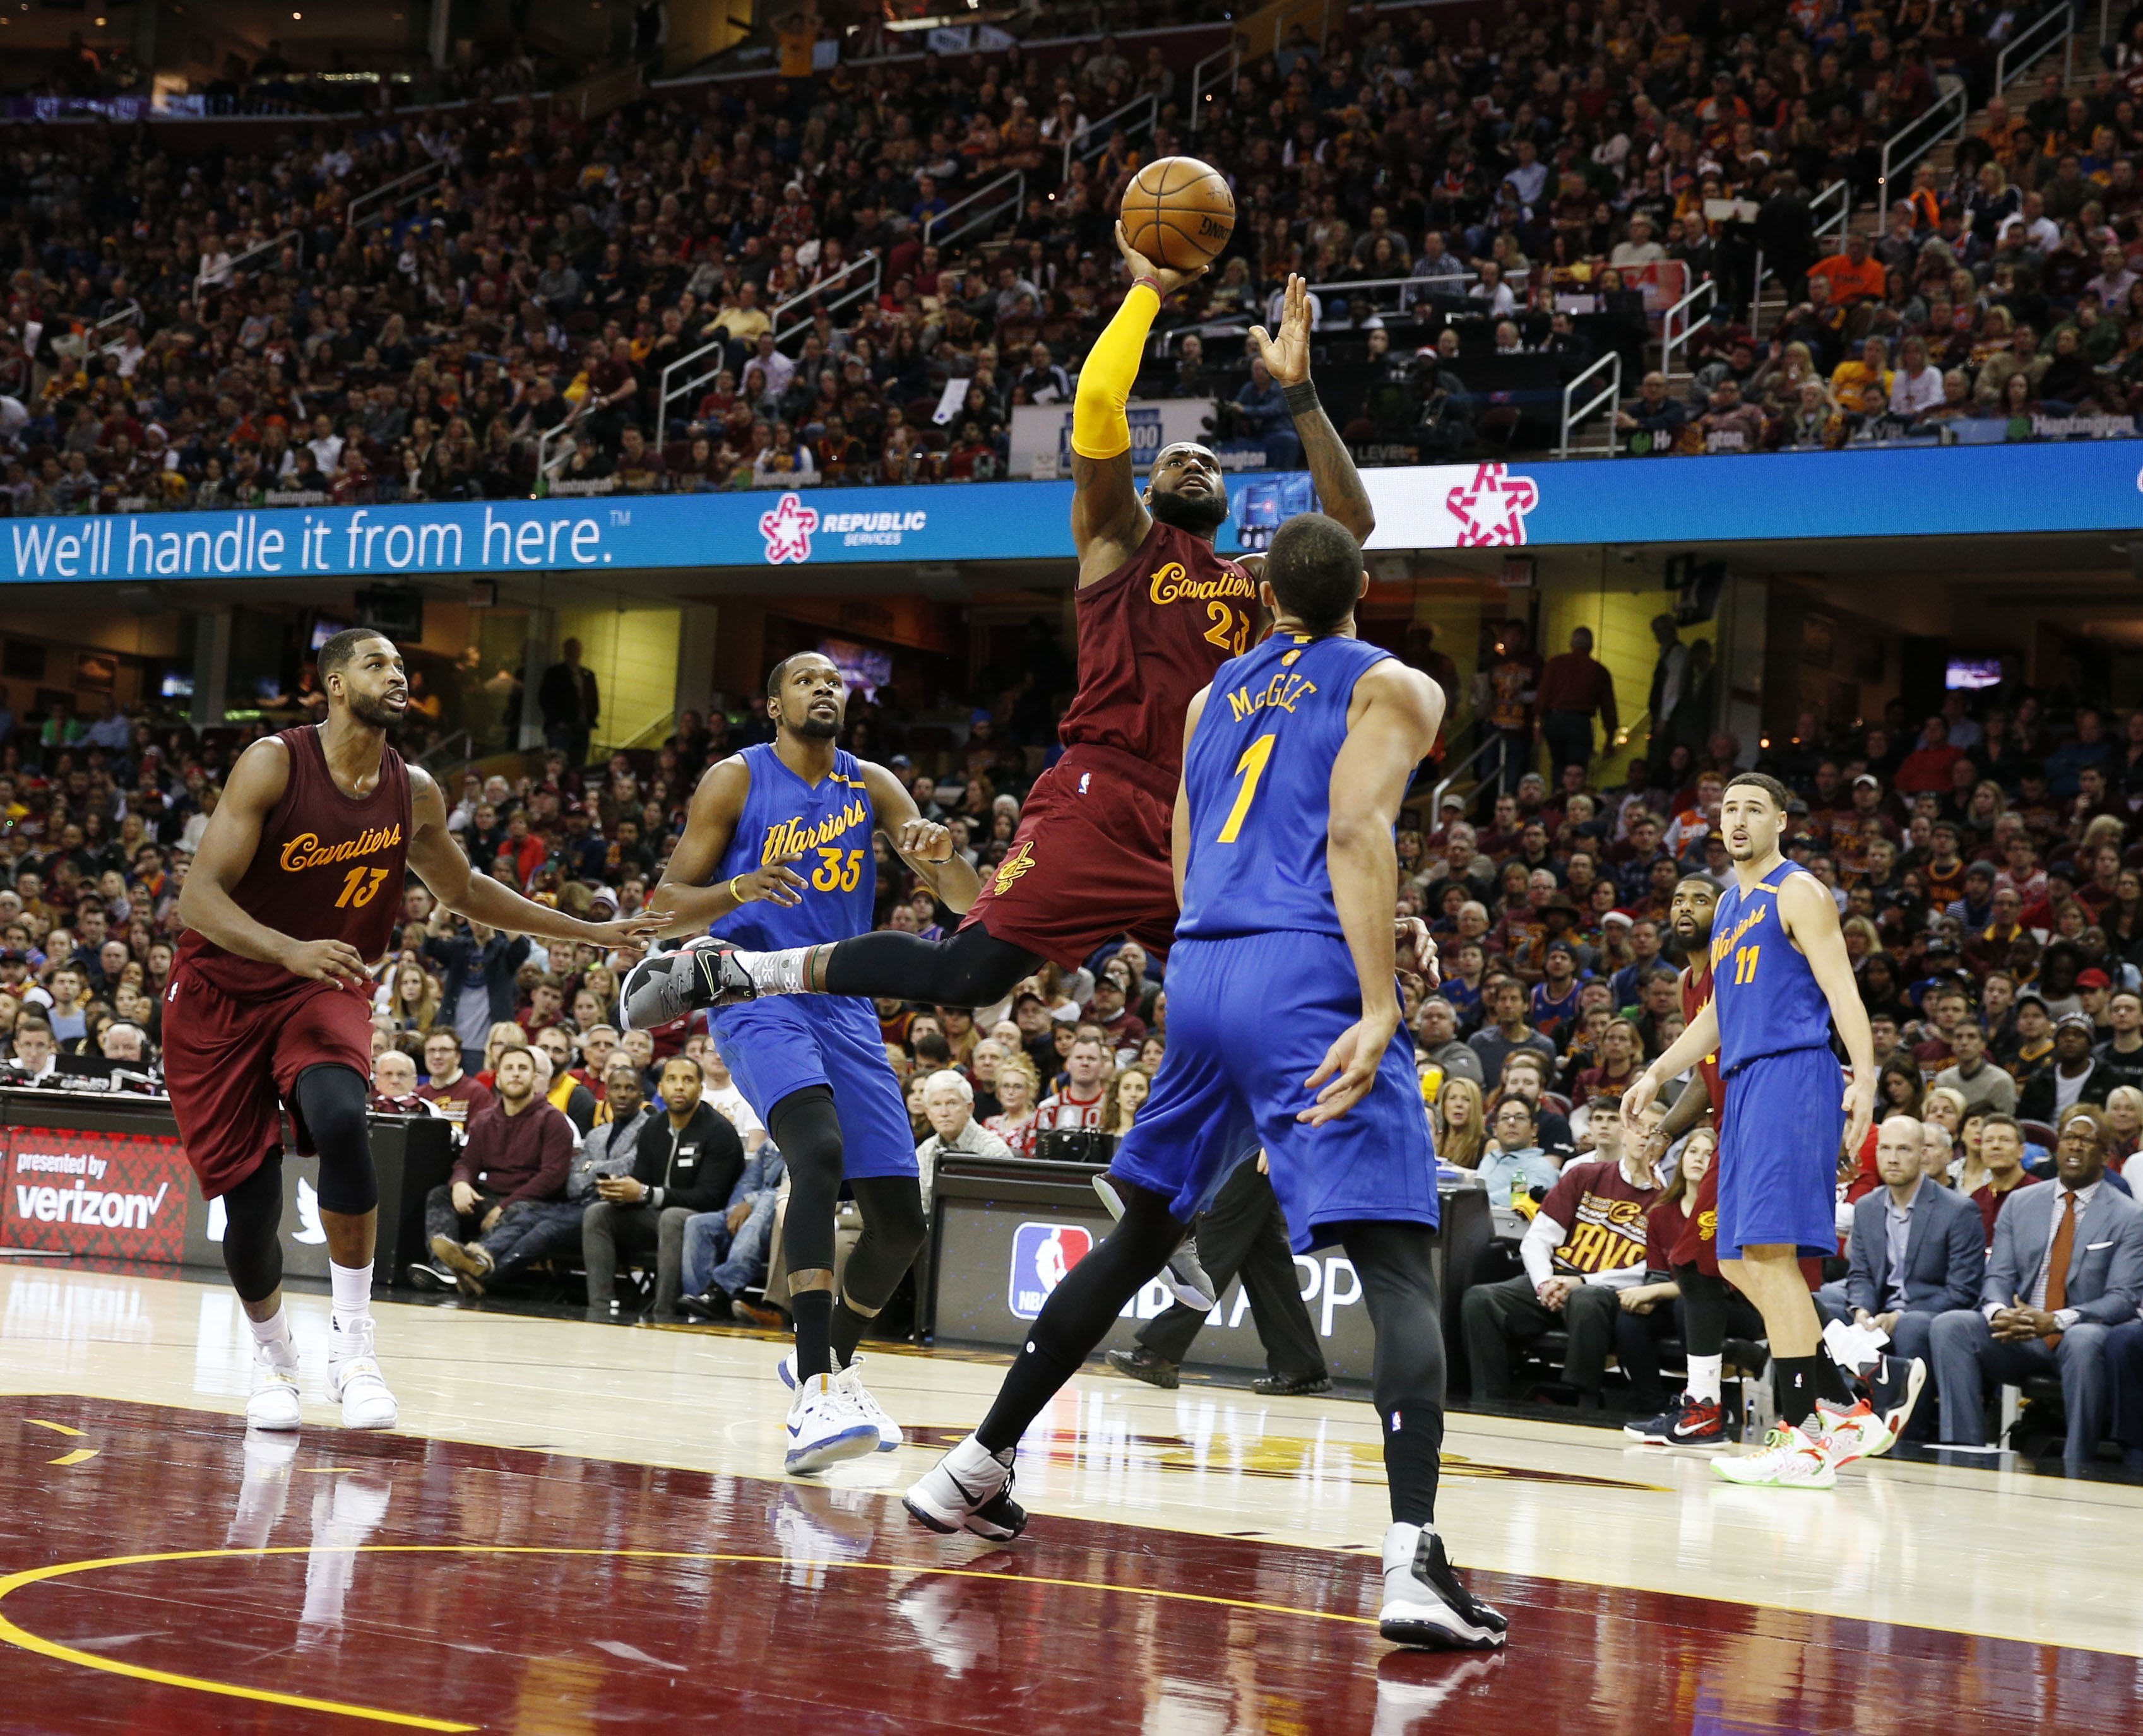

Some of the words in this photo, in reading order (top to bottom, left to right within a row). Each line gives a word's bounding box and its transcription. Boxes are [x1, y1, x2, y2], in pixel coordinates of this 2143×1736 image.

[13, 519, 112, 577] We'll
[128, 514, 285, 574] handle
[301, 514, 331, 570] it
[346, 509, 463, 569] from
[482, 505, 612, 565] here.
[822, 511, 927, 533] REPUBLIC
[843, 531, 902, 547] SERVICES
[1150, 562, 1257, 605] Cavaliers
[1216, 733, 1277, 843] 1
[280, 822, 401, 872] Cavaliers
[761, 799, 866, 867] Warriors
[334, 866, 389, 909] 13
[812, 847, 865, 892] 35
[1735, 945, 1760, 985] 11
[16, 1153, 86, 1174] presented
[87, 1154, 107, 1180] by
[16, 1179, 150, 1229] verizon
